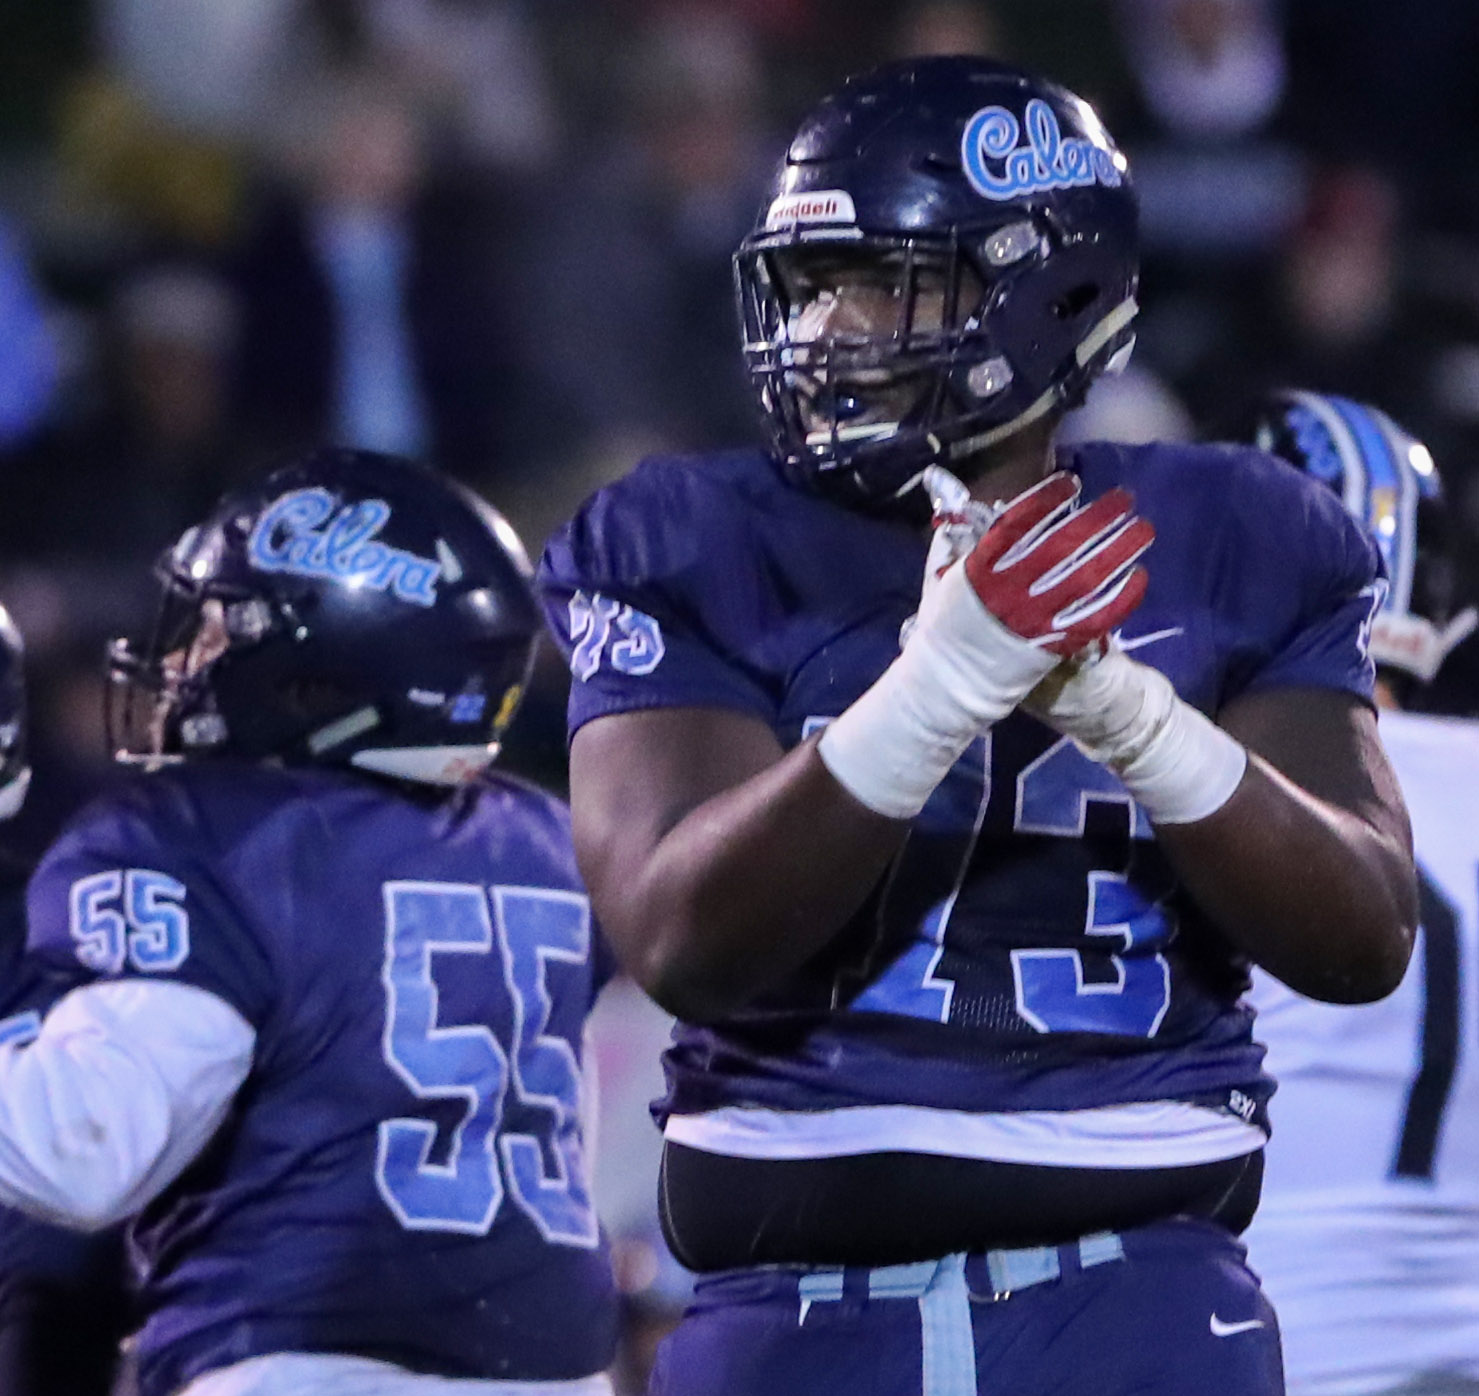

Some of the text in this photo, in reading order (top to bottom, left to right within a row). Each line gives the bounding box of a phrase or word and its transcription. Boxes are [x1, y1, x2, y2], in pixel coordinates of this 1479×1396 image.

[249, 486, 442, 608] Calera
[69, 867, 191, 974] 55
[375, 879, 600, 1250] 55
